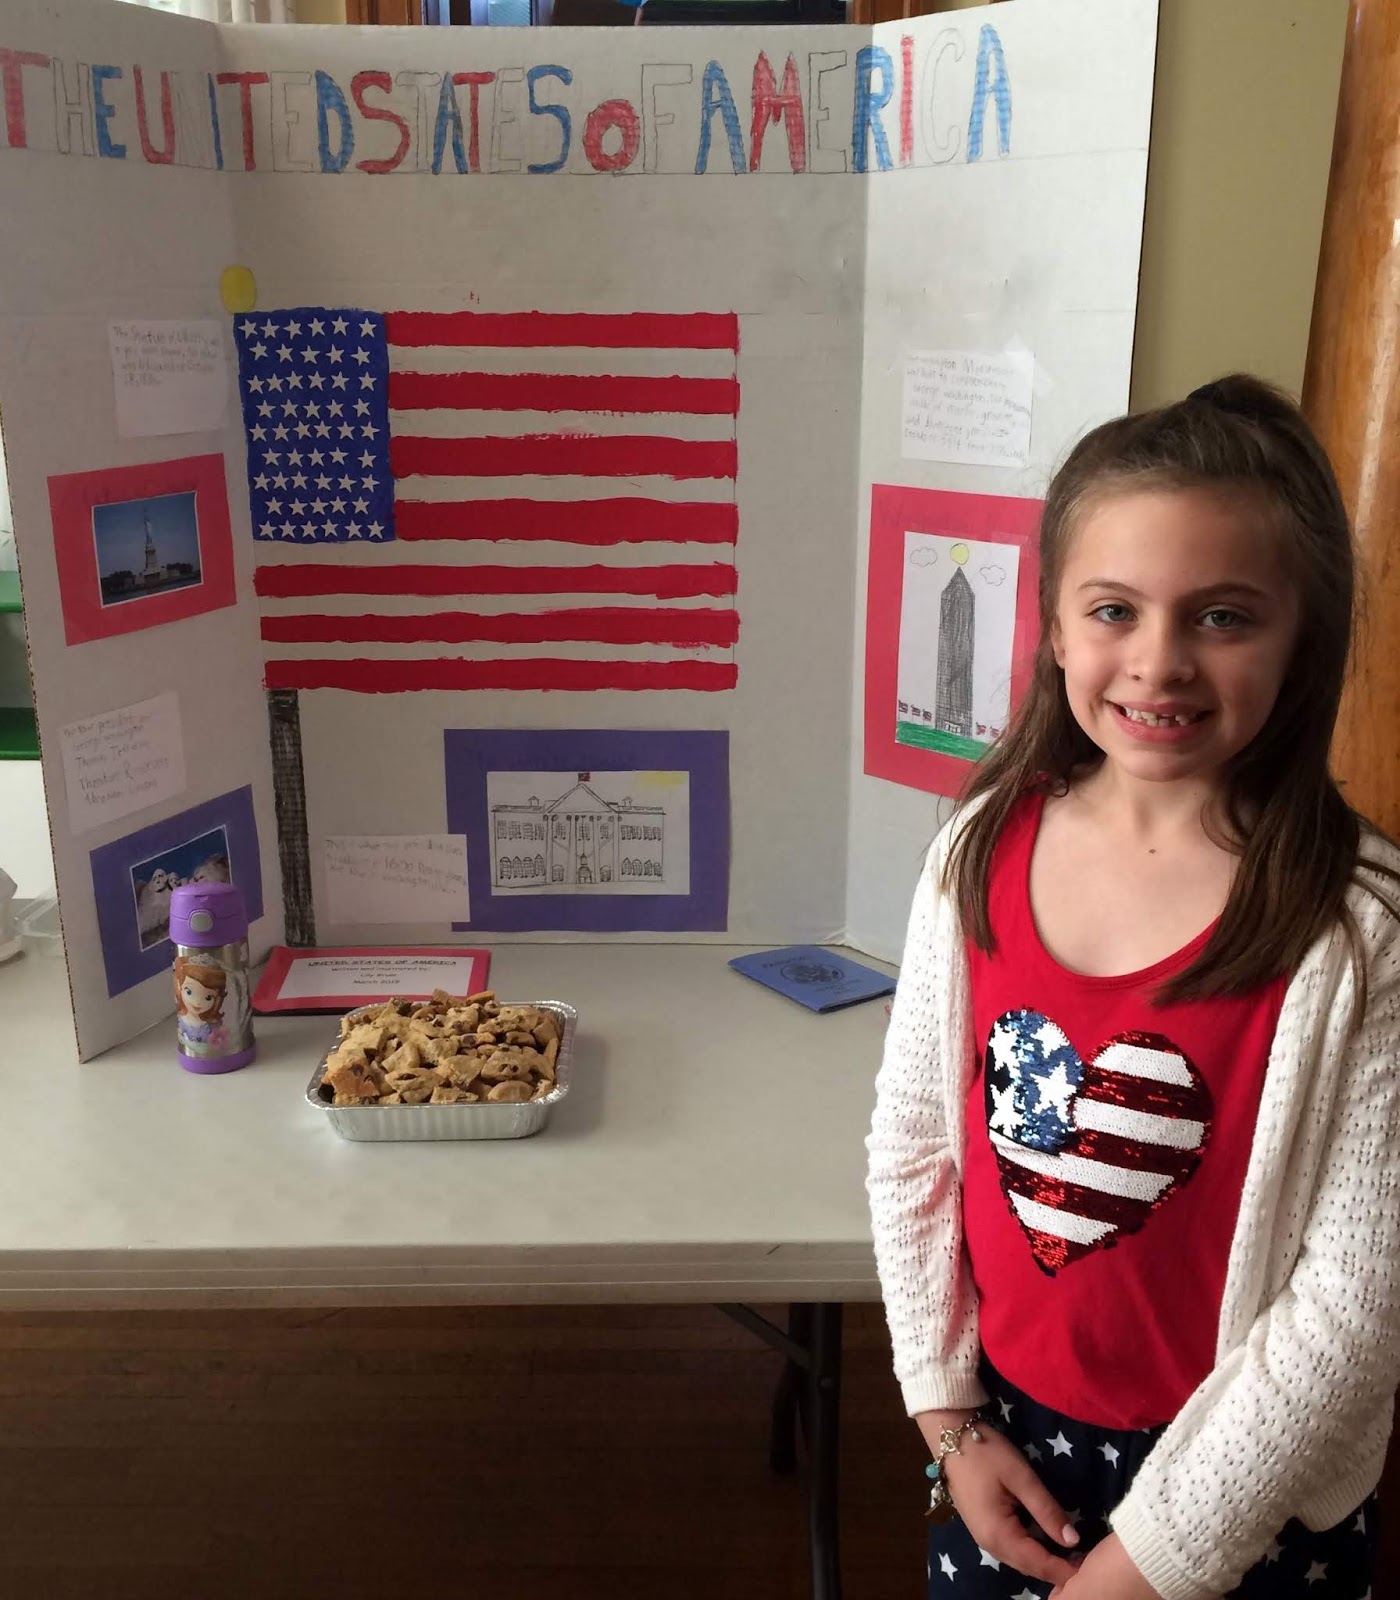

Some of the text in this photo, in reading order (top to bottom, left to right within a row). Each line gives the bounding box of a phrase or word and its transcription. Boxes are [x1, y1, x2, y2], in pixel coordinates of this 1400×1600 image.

[0, 46, 127, 159] THE
[132, 63, 354, 175] UNITED
[350, 63, 574, 175] STATES
[694, 22, 1013, 175] AMERICA
